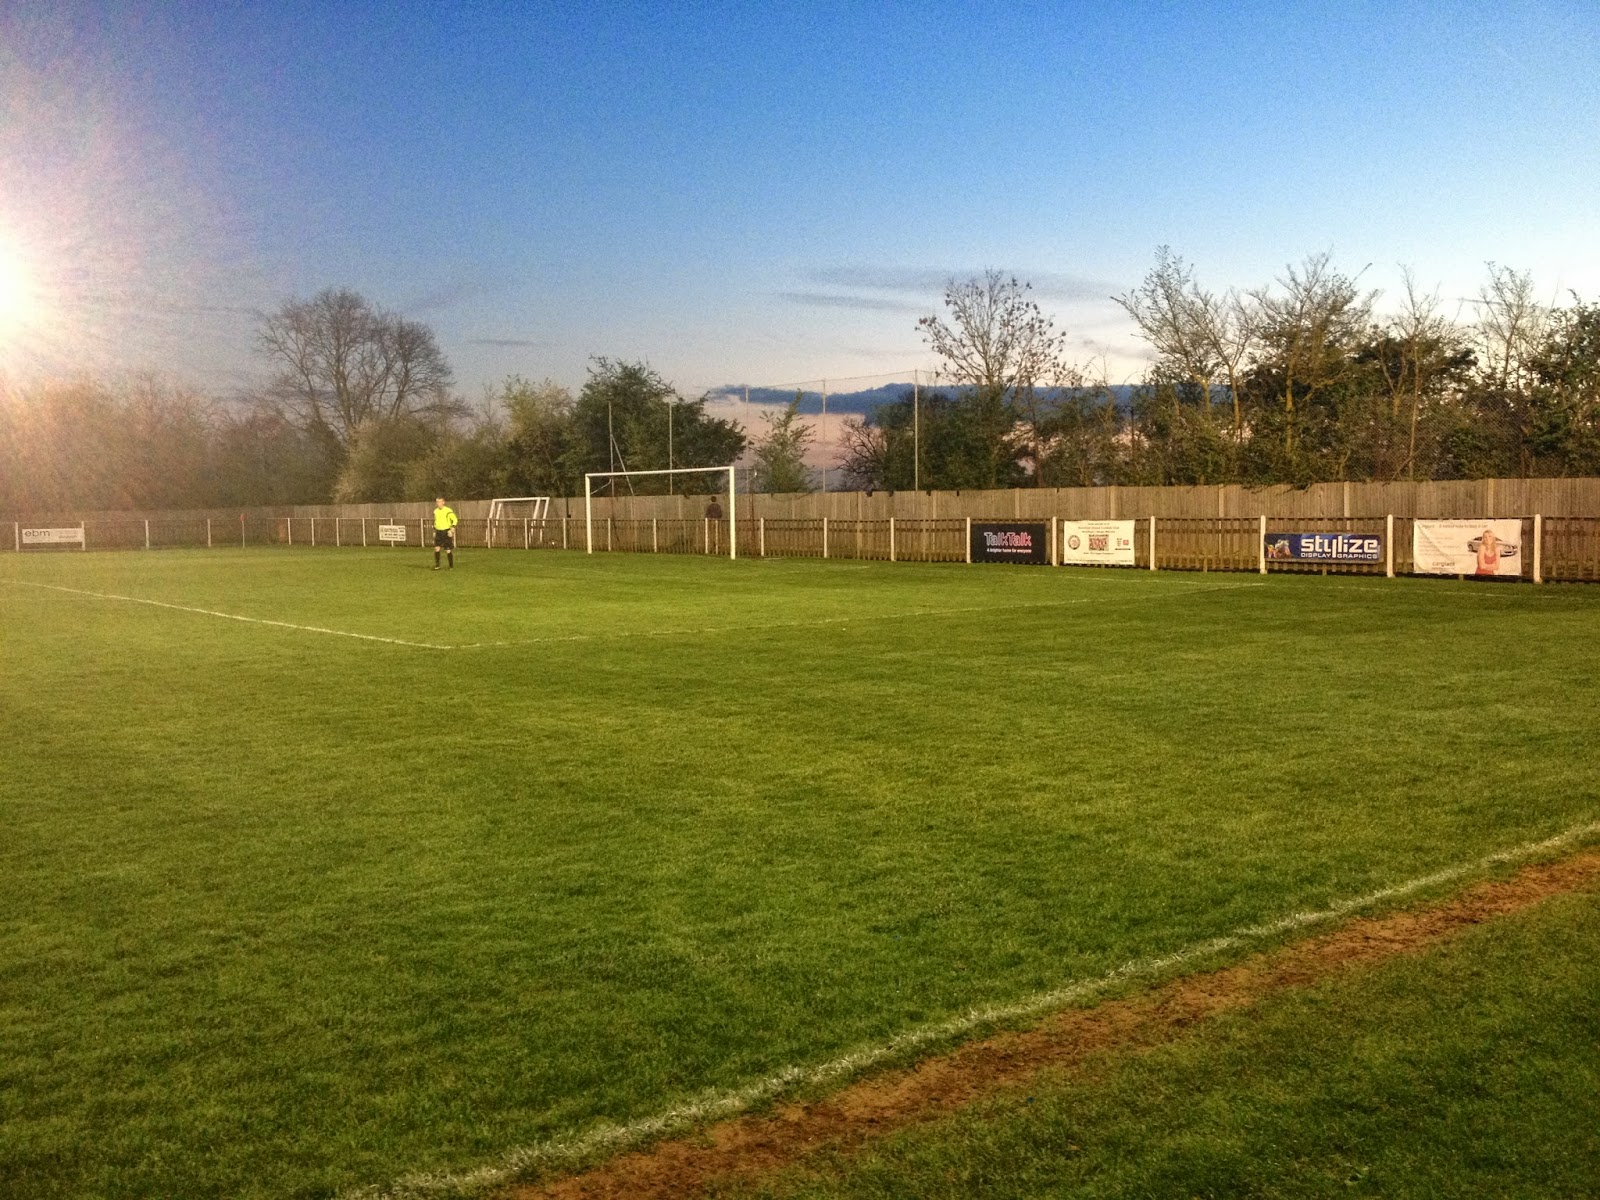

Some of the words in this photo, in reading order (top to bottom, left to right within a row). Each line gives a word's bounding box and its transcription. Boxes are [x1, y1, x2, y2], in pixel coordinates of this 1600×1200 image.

[24, 529, 51, 537] ebm
[984, 532, 1031, 546] TalkTalk
[1301, 535, 1378, 558] stylize
